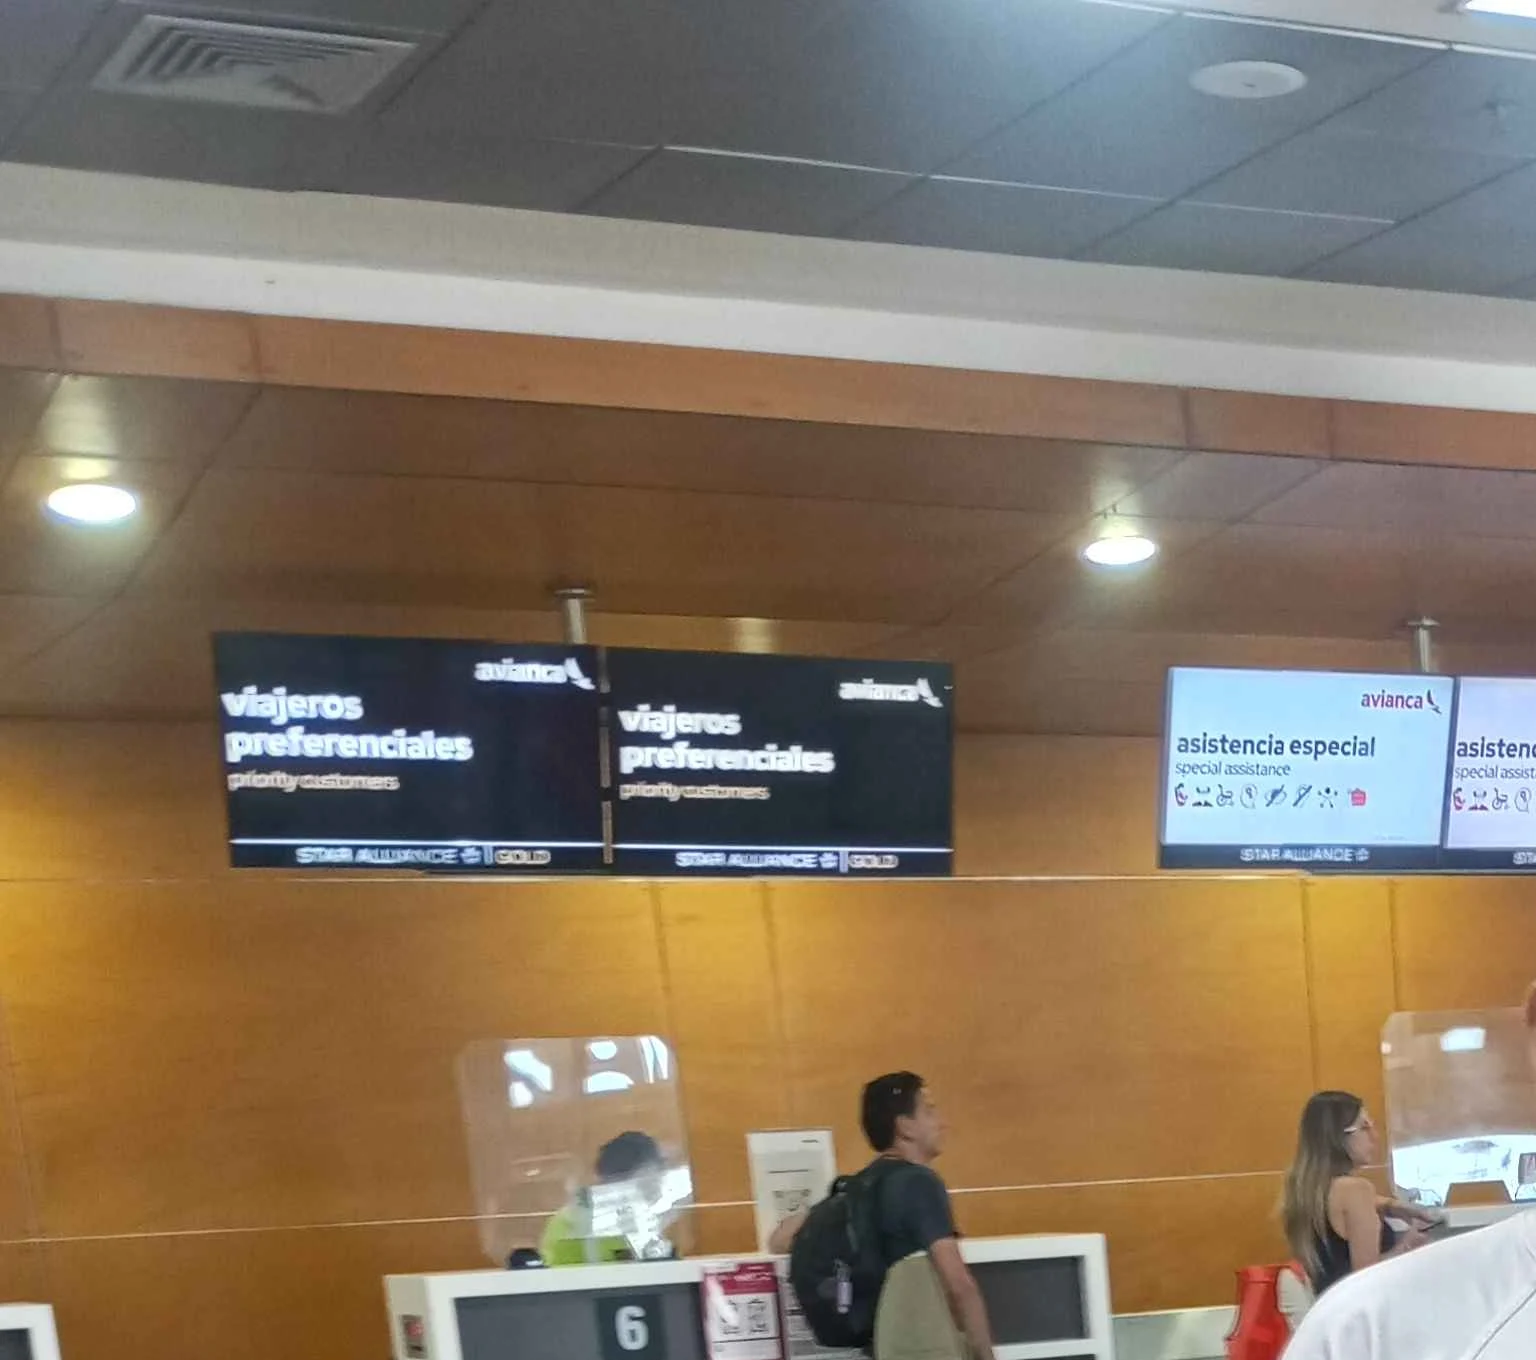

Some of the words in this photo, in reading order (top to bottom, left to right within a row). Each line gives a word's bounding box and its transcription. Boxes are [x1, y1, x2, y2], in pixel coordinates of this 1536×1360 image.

[474, 658, 567, 684] avianca
[838, 677, 919, 702] avianca
[1361, 690, 1424, 710] avianca
[220, 685, 364, 725] viajeros
[617, 703, 742, 740] viajeros
[225, 726, 474, 763] preferenciales
[619, 740, 835, 774] preferenciales
[1177, 732, 1285, 756] asistencia
[1289, 735, 1376, 761] especial
[1175, 760, 1222, 778] special
[1224, 763, 1291, 777] assistance
[1454, 764, 1499, 780] special
[295, 847, 354, 864] STAR
[675, 851, 726, 867] STAR
[1239, 848, 1280, 862] STAR
[1281, 848, 1355, 862] ALLIANCE
[614, 1305, 649, 1351] 6
